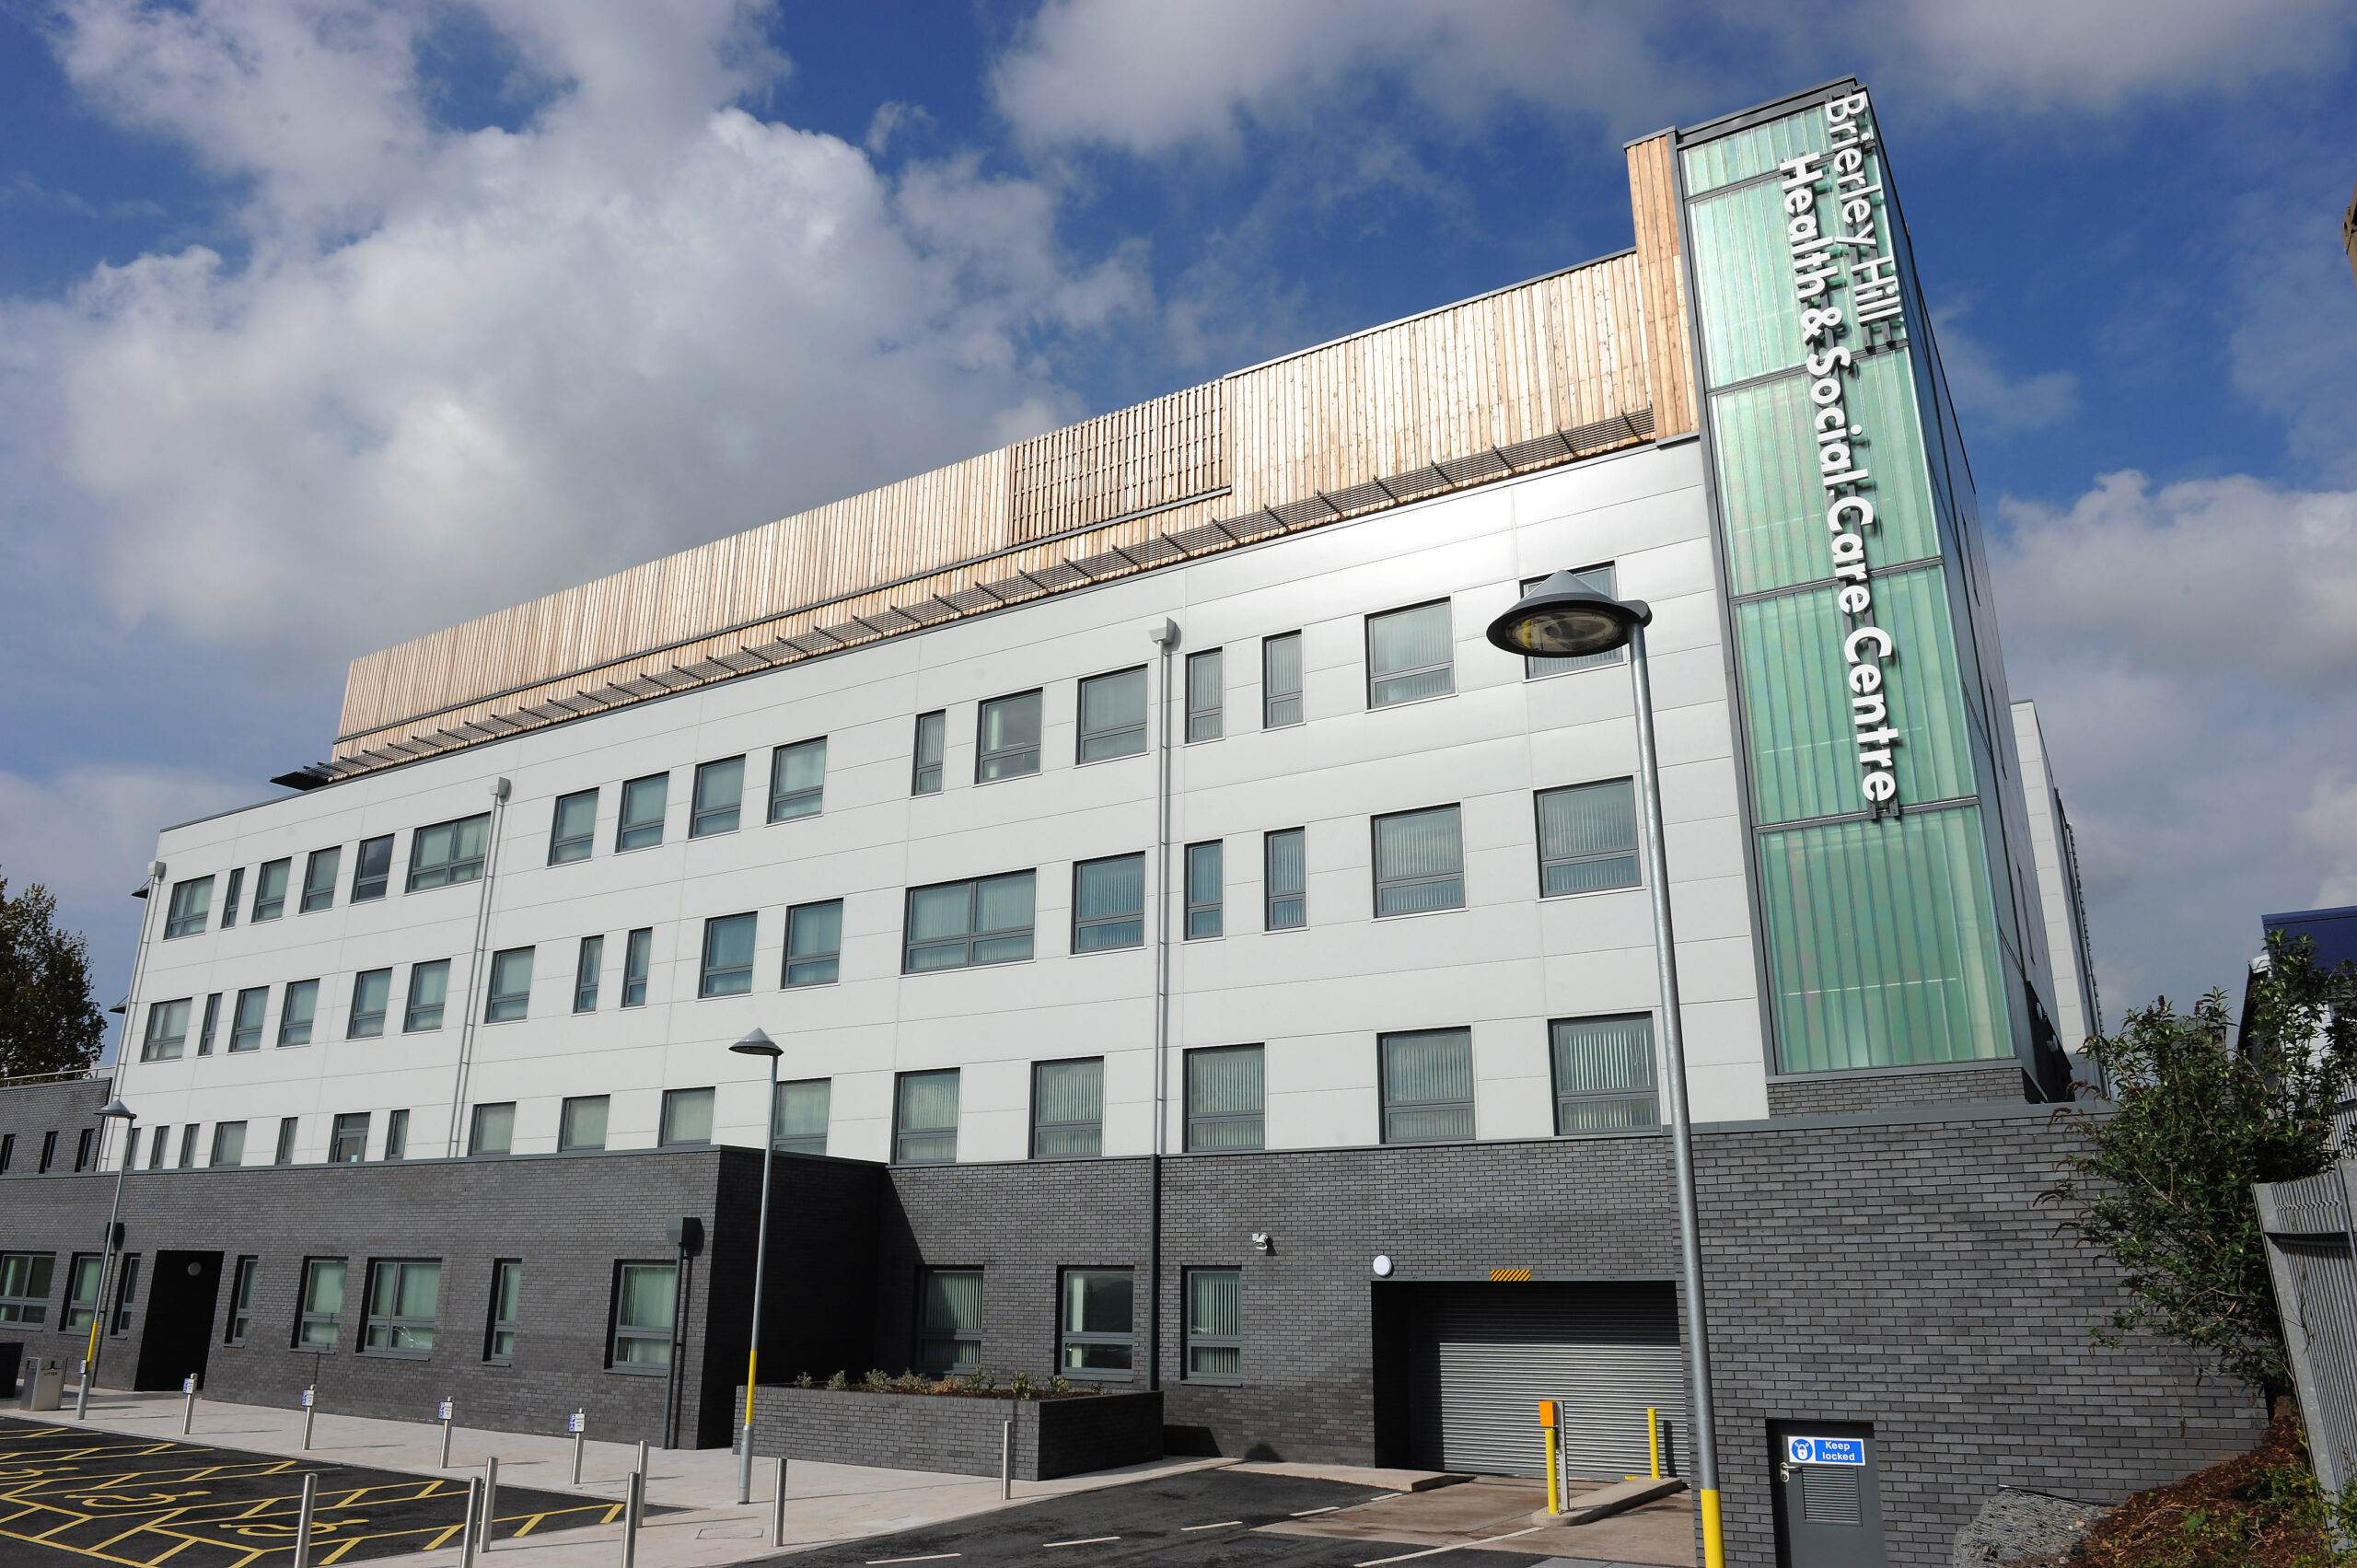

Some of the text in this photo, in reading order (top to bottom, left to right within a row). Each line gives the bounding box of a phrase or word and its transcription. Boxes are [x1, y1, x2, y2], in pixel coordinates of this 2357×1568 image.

[1825, 91, 1902, 325] Brierley Hill
[1779, 151, 1899, 802] Health & Social Care Centre
[1822, 1451, 1855, 1461] locked
[1825, 1441, 1851, 1452] Keep
